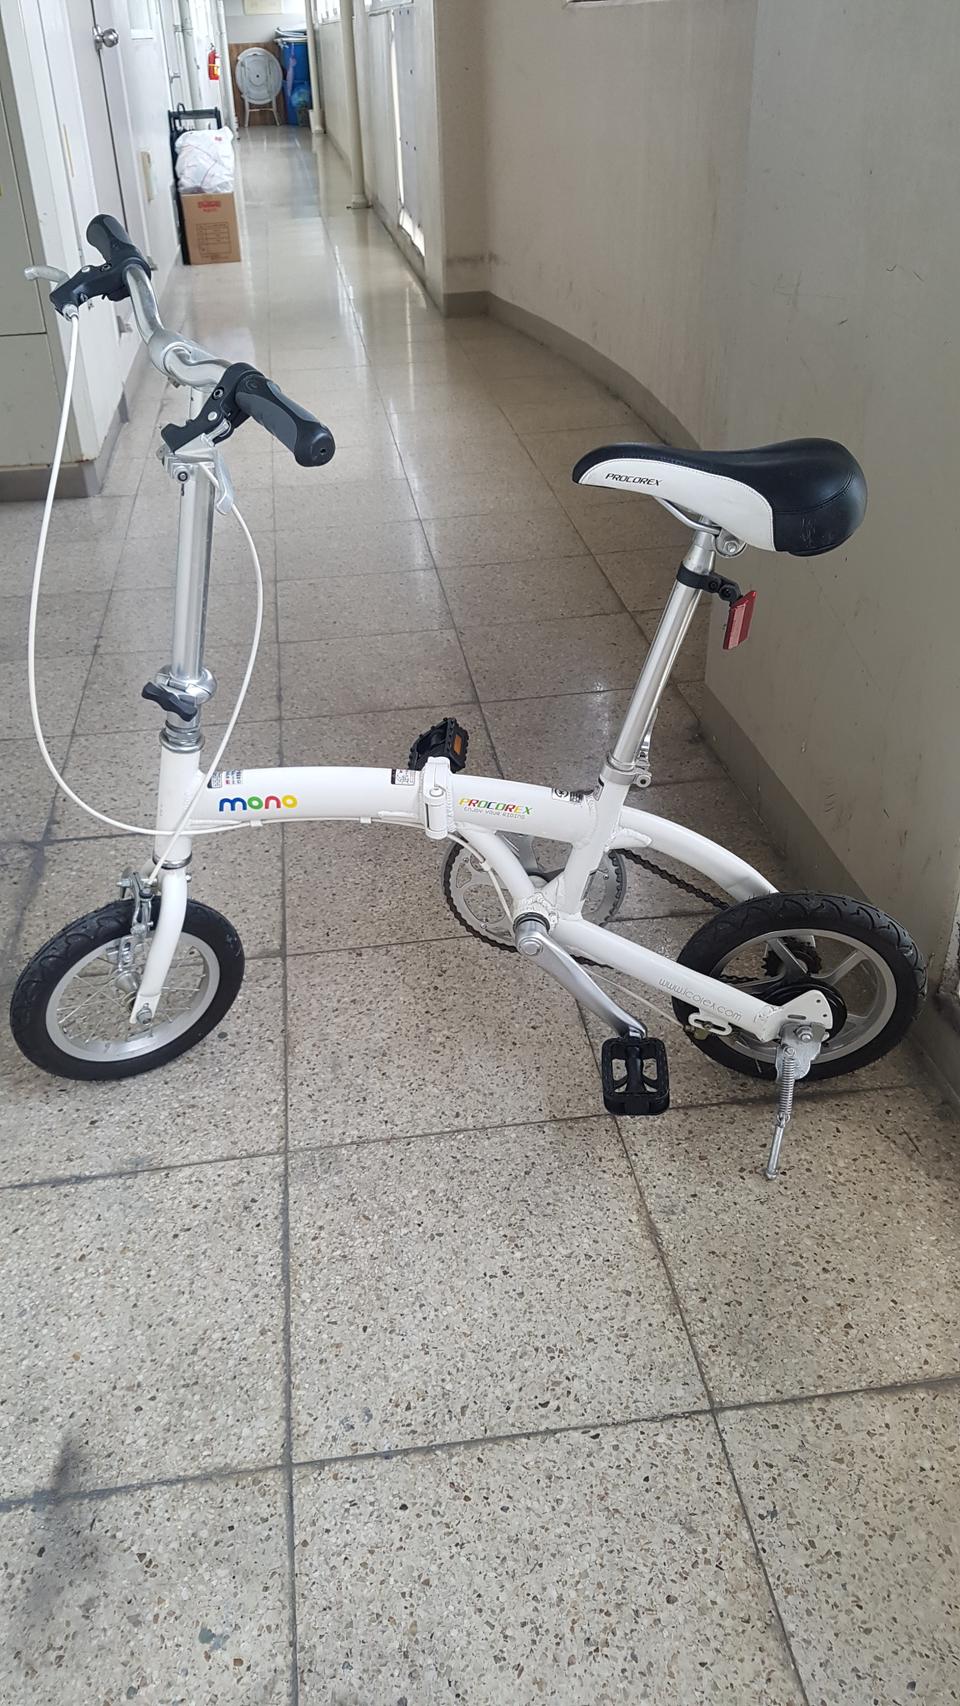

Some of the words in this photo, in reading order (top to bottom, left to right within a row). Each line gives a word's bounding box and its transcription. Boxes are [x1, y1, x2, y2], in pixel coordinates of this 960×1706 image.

[605, 472, 661, 486] PROCOREX
[219, 794, 298, 812] mono
[459, 798, 533, 815] PROCOREX
